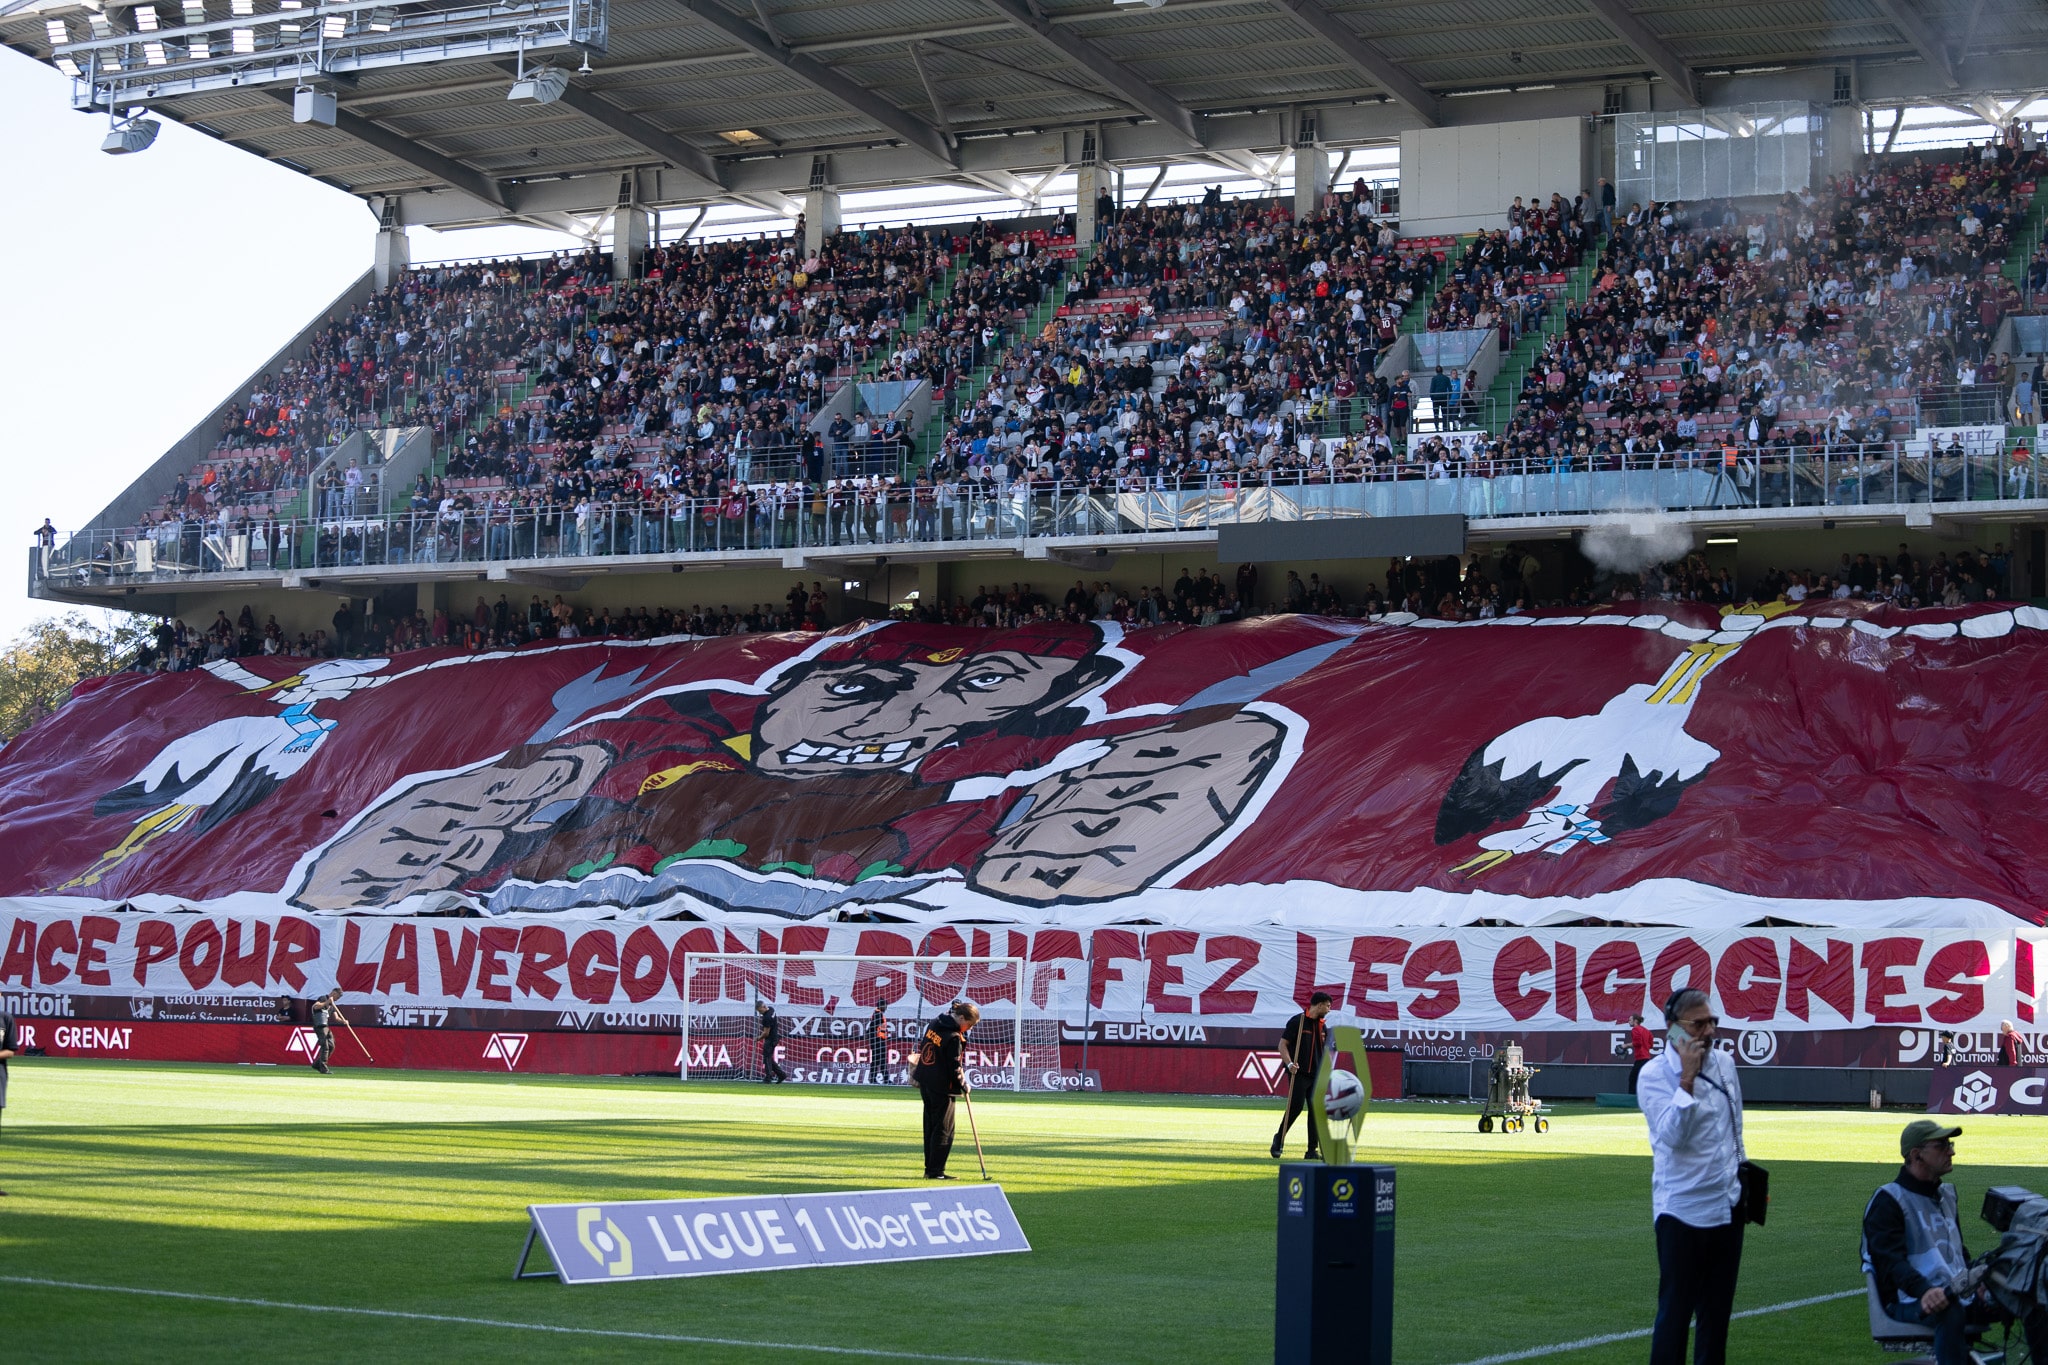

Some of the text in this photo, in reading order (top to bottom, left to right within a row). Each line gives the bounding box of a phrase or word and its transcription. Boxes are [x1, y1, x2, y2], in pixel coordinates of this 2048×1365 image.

[133, 916, 320, 991] POUR
[1293, 931, 1463, 1021] LES
[1493, 935, 1990, 1024] CIGOGNES
[164, 995, 276, 1008] GROUPE Heracles
[604, 1012, 650, 1026] axia
[55, 1026, 133, 1050] GRENAT
[1104, 1024, 1207, 1041] EUROVIA
[674, 1044, 732, 1068] AXIA
[1469, 1044, 1495, 1058] e-ID
[965, 1069, 1016, 1088] Carola
[1043, 1071, 1095, 1089] Carola
[1376, 1179, 1394, 1194] Uber
[1376, 1196, 1394, 1212] Eats
[647, 1201, 1000, 1262] LIGUE 1 Uber Eats
